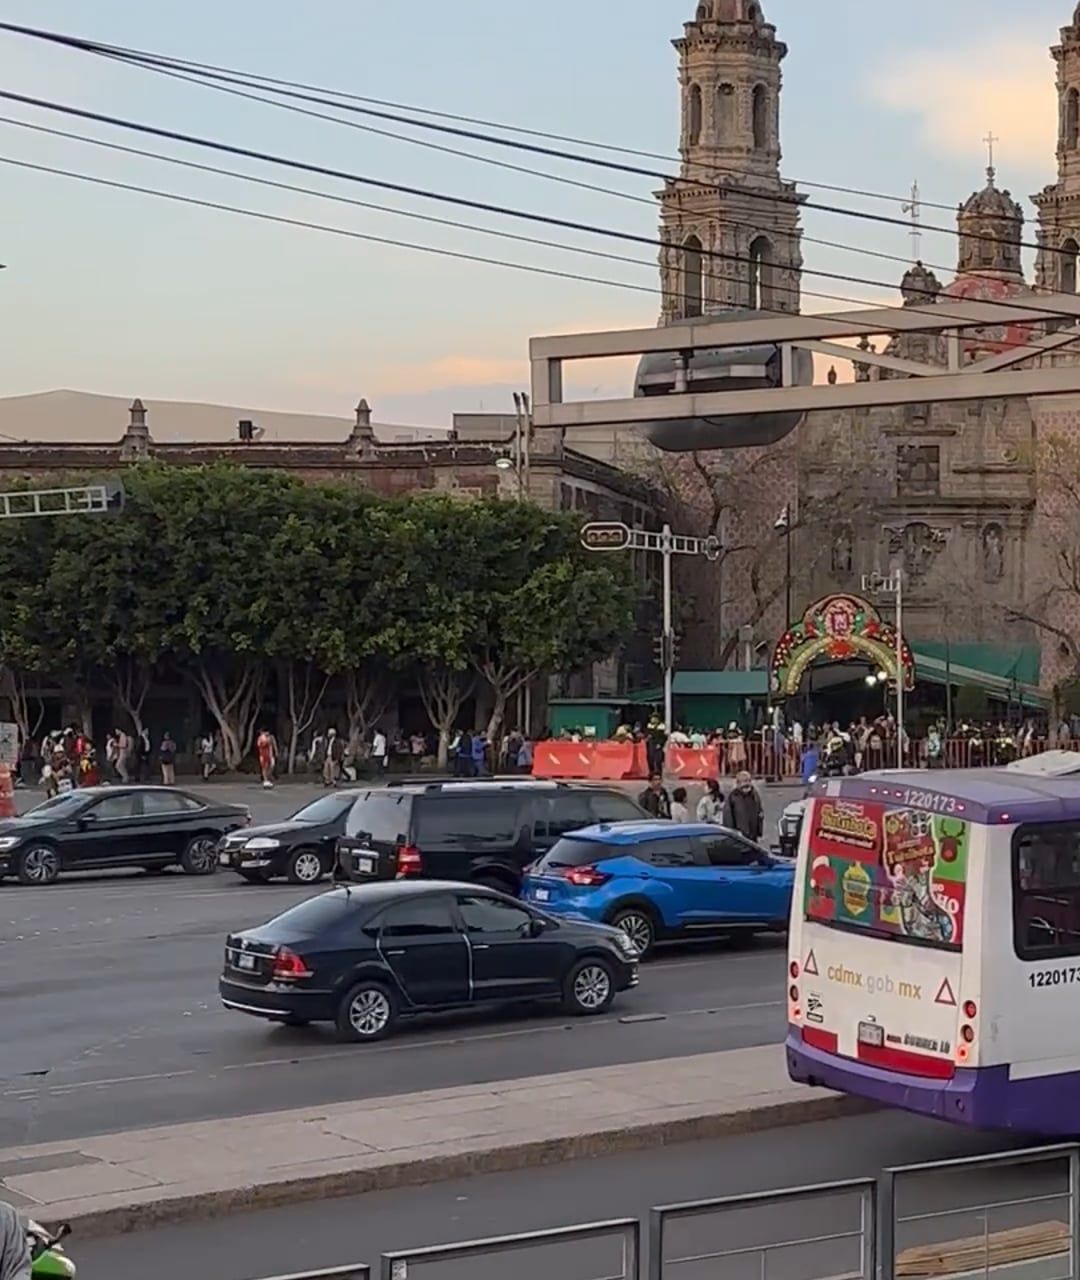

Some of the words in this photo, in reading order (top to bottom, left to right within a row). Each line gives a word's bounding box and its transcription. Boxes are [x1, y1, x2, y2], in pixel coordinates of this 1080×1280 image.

[904, 790, 956, 812] 1220173
[828, 963, 863, 987] cdmx
[866, 974, 894, 994] gob
[898, 981, 921, 1000] mx
